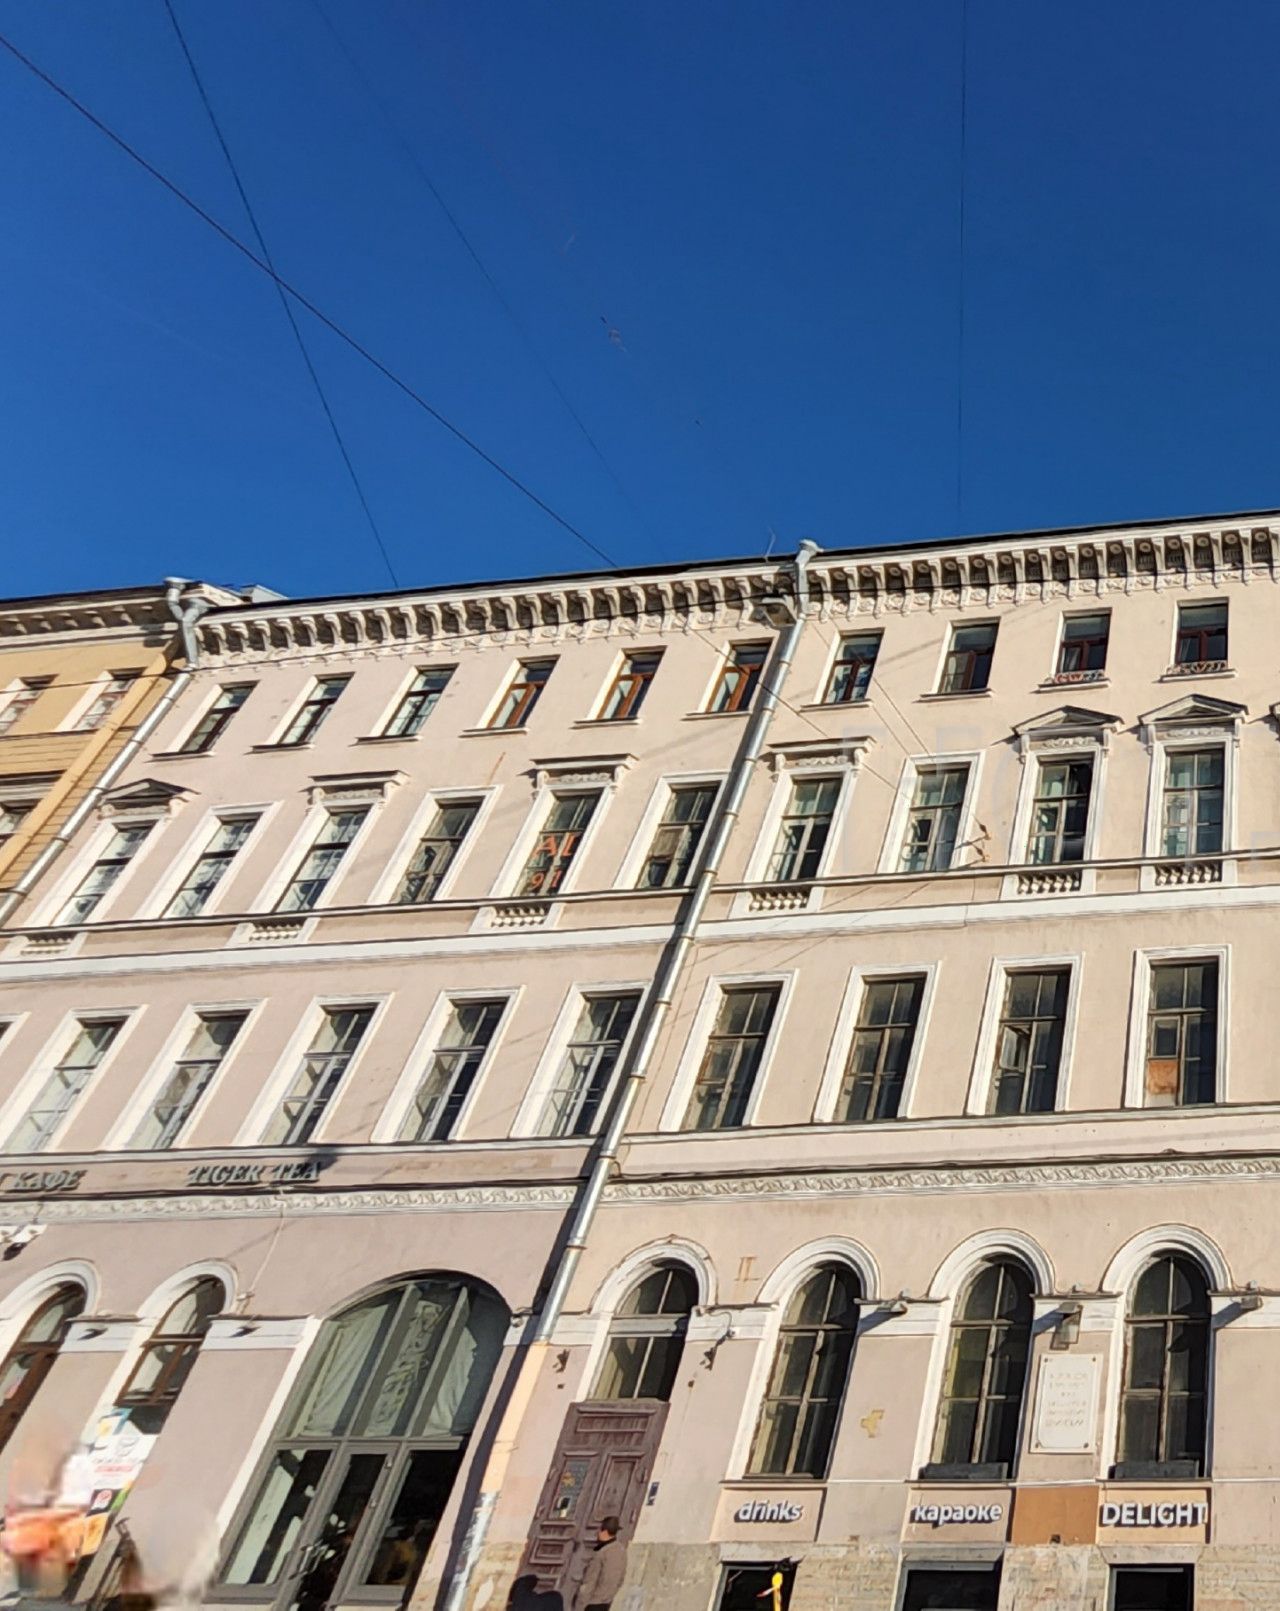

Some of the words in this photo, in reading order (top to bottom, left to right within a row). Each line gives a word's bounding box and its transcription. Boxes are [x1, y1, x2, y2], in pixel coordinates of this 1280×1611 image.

[9, 1170, 86, 1191] КАФЕ
[190, 1164, 264, 1184] TIGER
[271, 1162, 320, 1182] TEA
[738, 1499, 803, 1521] drinks
[914, 1504, 1003, 1527] караоке
[1102, 1502, 1208, 1525] DELIGHT
